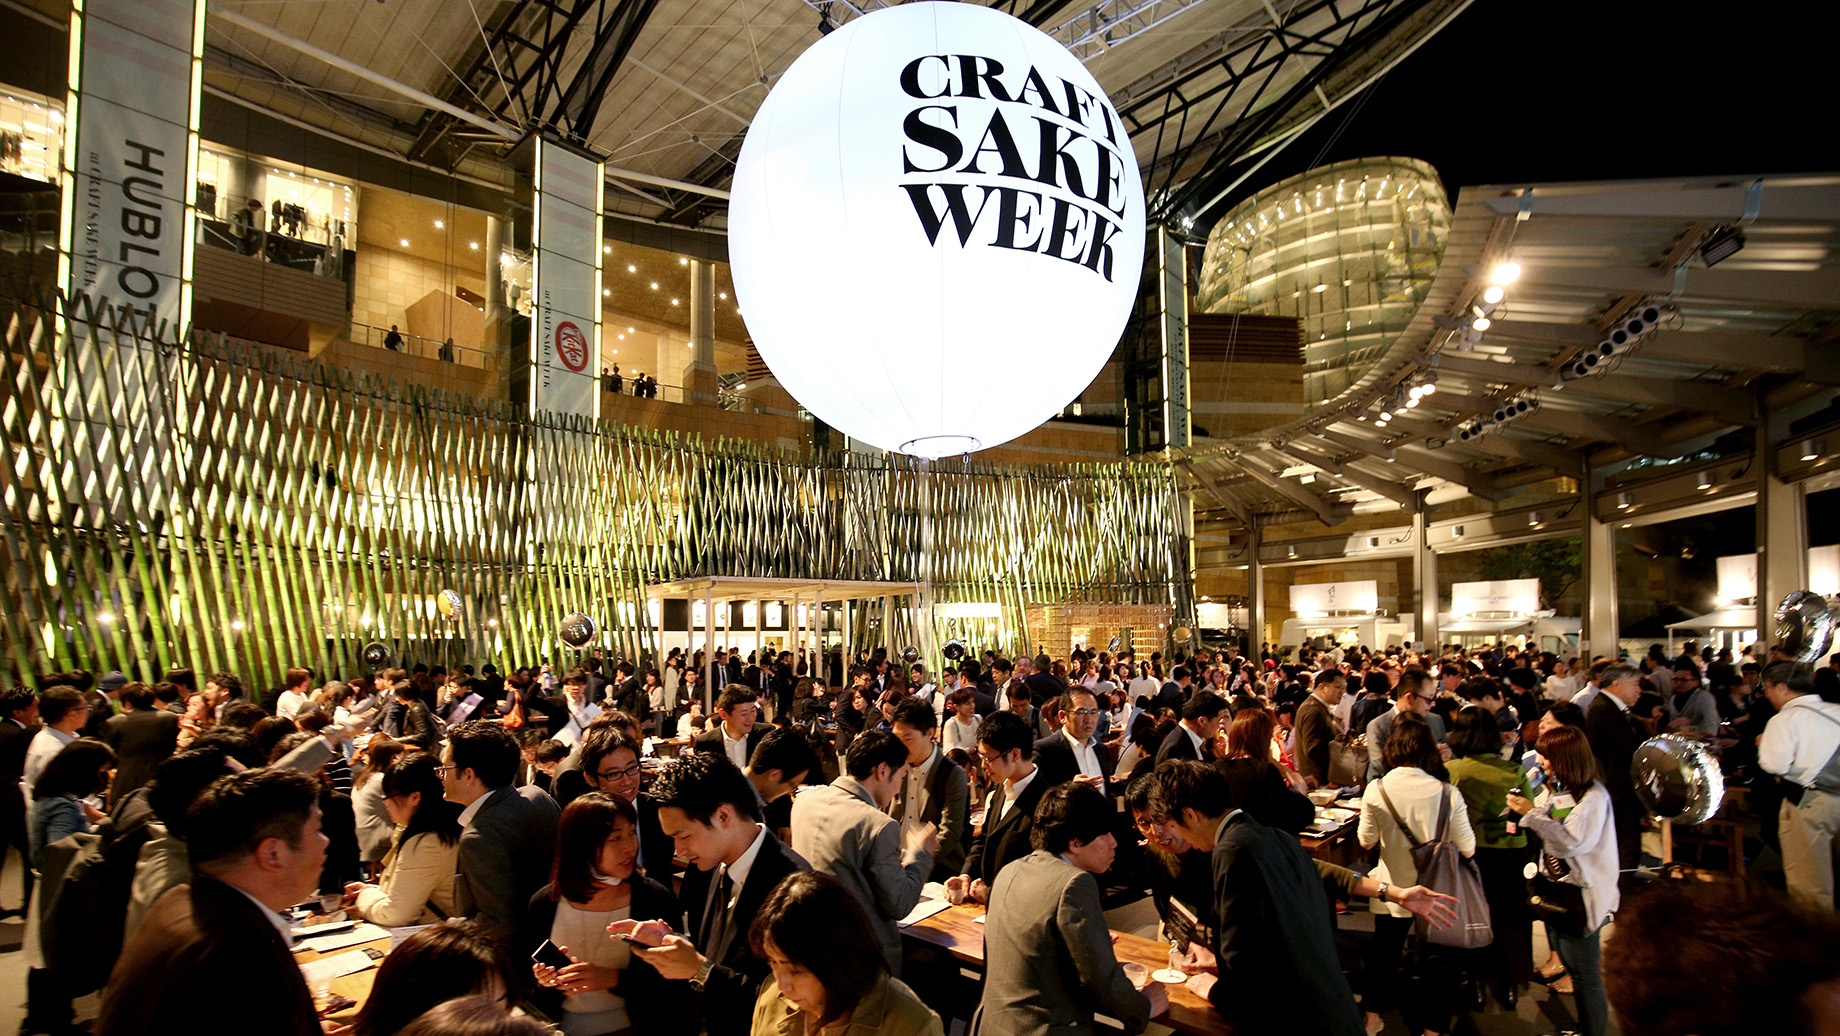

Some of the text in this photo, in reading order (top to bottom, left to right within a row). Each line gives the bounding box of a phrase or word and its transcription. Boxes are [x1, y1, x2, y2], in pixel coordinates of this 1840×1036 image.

[900, 54, 1121, 151] CRAFT
[903, 105, 1127, 220] SAKE
[84, 151, 102, 288] at CRAFT SAKE WEEK
[899, 183, 1123, 283] WEEK
